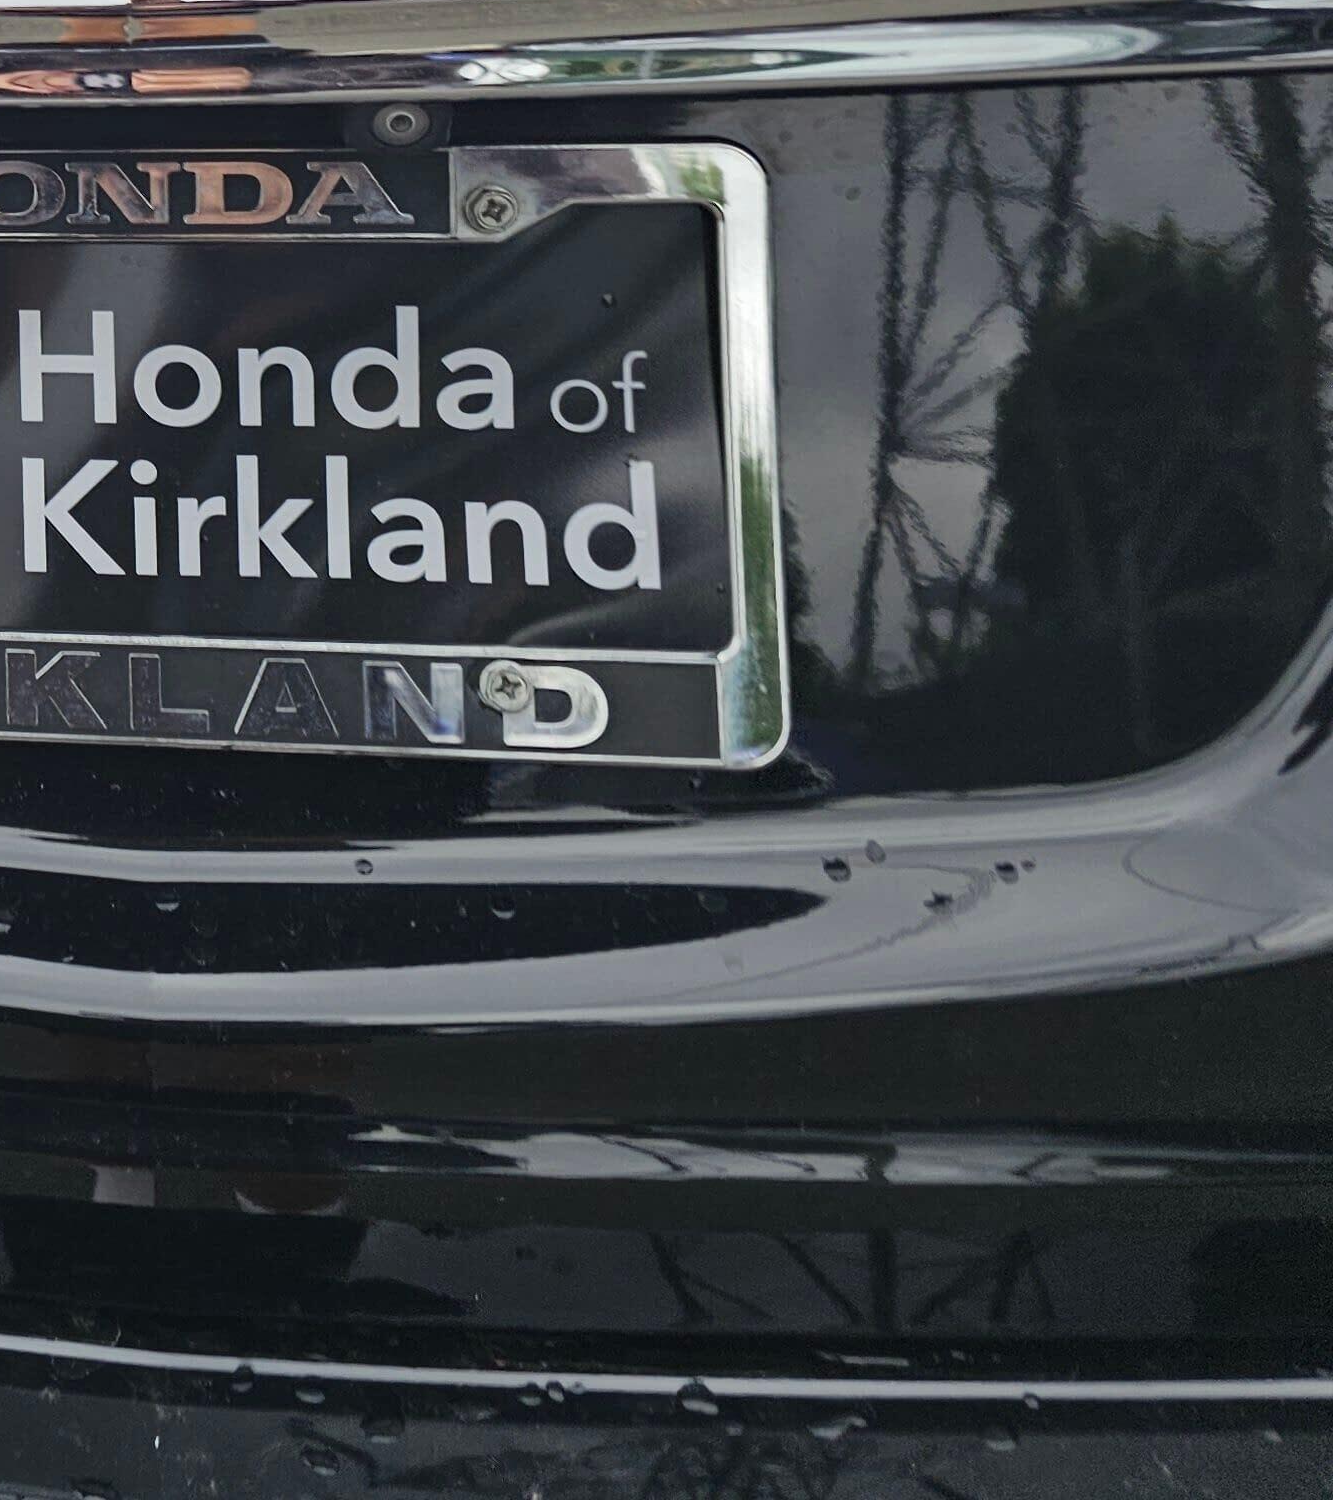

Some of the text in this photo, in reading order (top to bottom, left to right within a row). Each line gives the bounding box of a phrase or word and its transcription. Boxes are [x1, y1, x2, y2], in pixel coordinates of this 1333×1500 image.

[18, 306, 648, 434] Honda of
[21, 455, 661, 592] Kirkland
